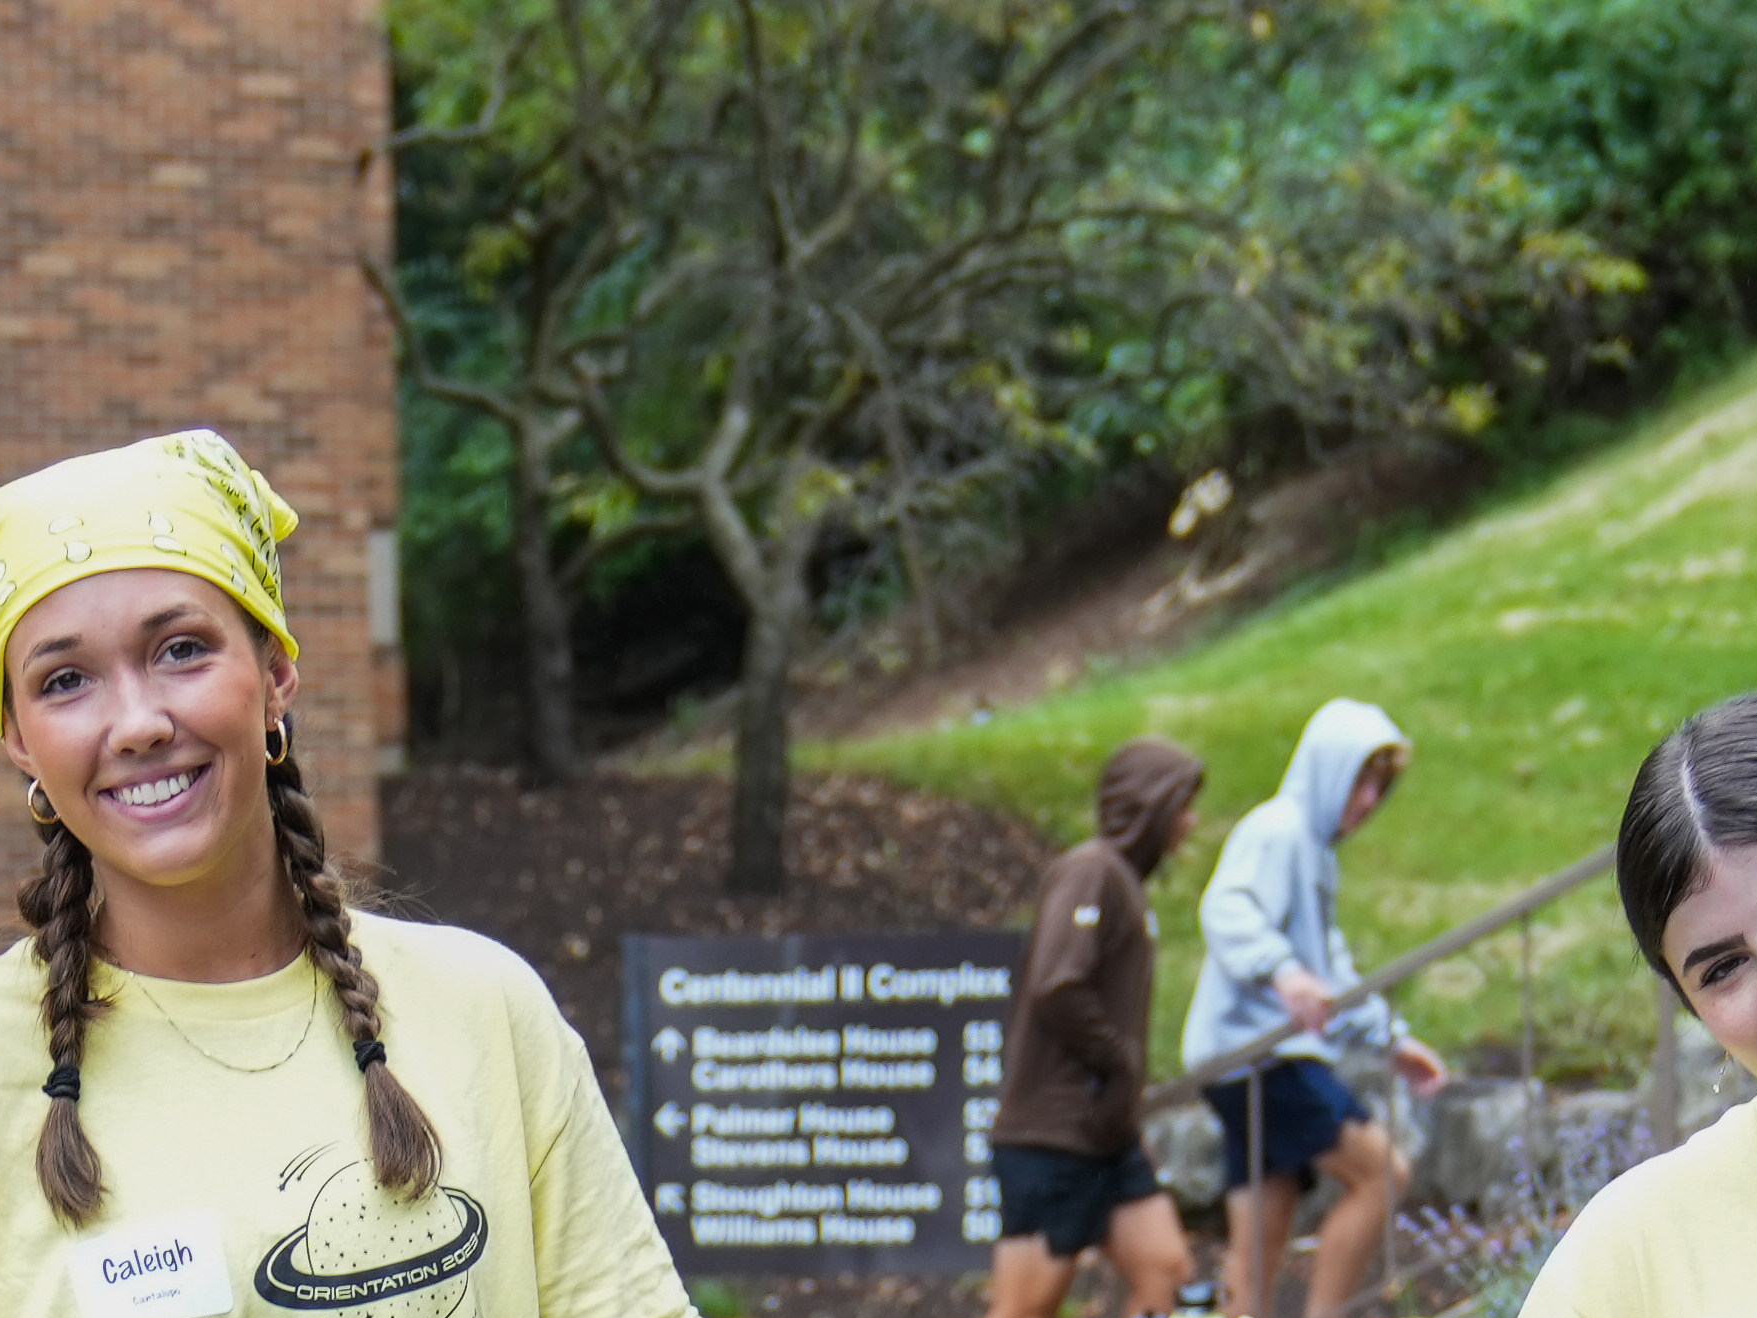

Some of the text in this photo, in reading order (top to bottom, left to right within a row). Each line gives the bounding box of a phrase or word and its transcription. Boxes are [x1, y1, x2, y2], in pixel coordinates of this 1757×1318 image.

[660, 962, 1011, 1005] Centennial II Complex
[692, 1021, 1002, 1059] Beardslee House 55
[691, 1053, 1001, 1091] Carothers House 54
[691, 1104, 795, 1135] Palmer
[798, 1102, 895, 1133] House
[691, 1130, 992, 1167] Stevens House 5
[691, 1180, 844, 1217] Stoughton
[847, 1179, 942, 1211] House
[691, 1210, 1002, 1244] Williams House 50
[102, 1238, 193, 1284] Caleigh
[296, 1263, 439, 1301] ORIENTATION
